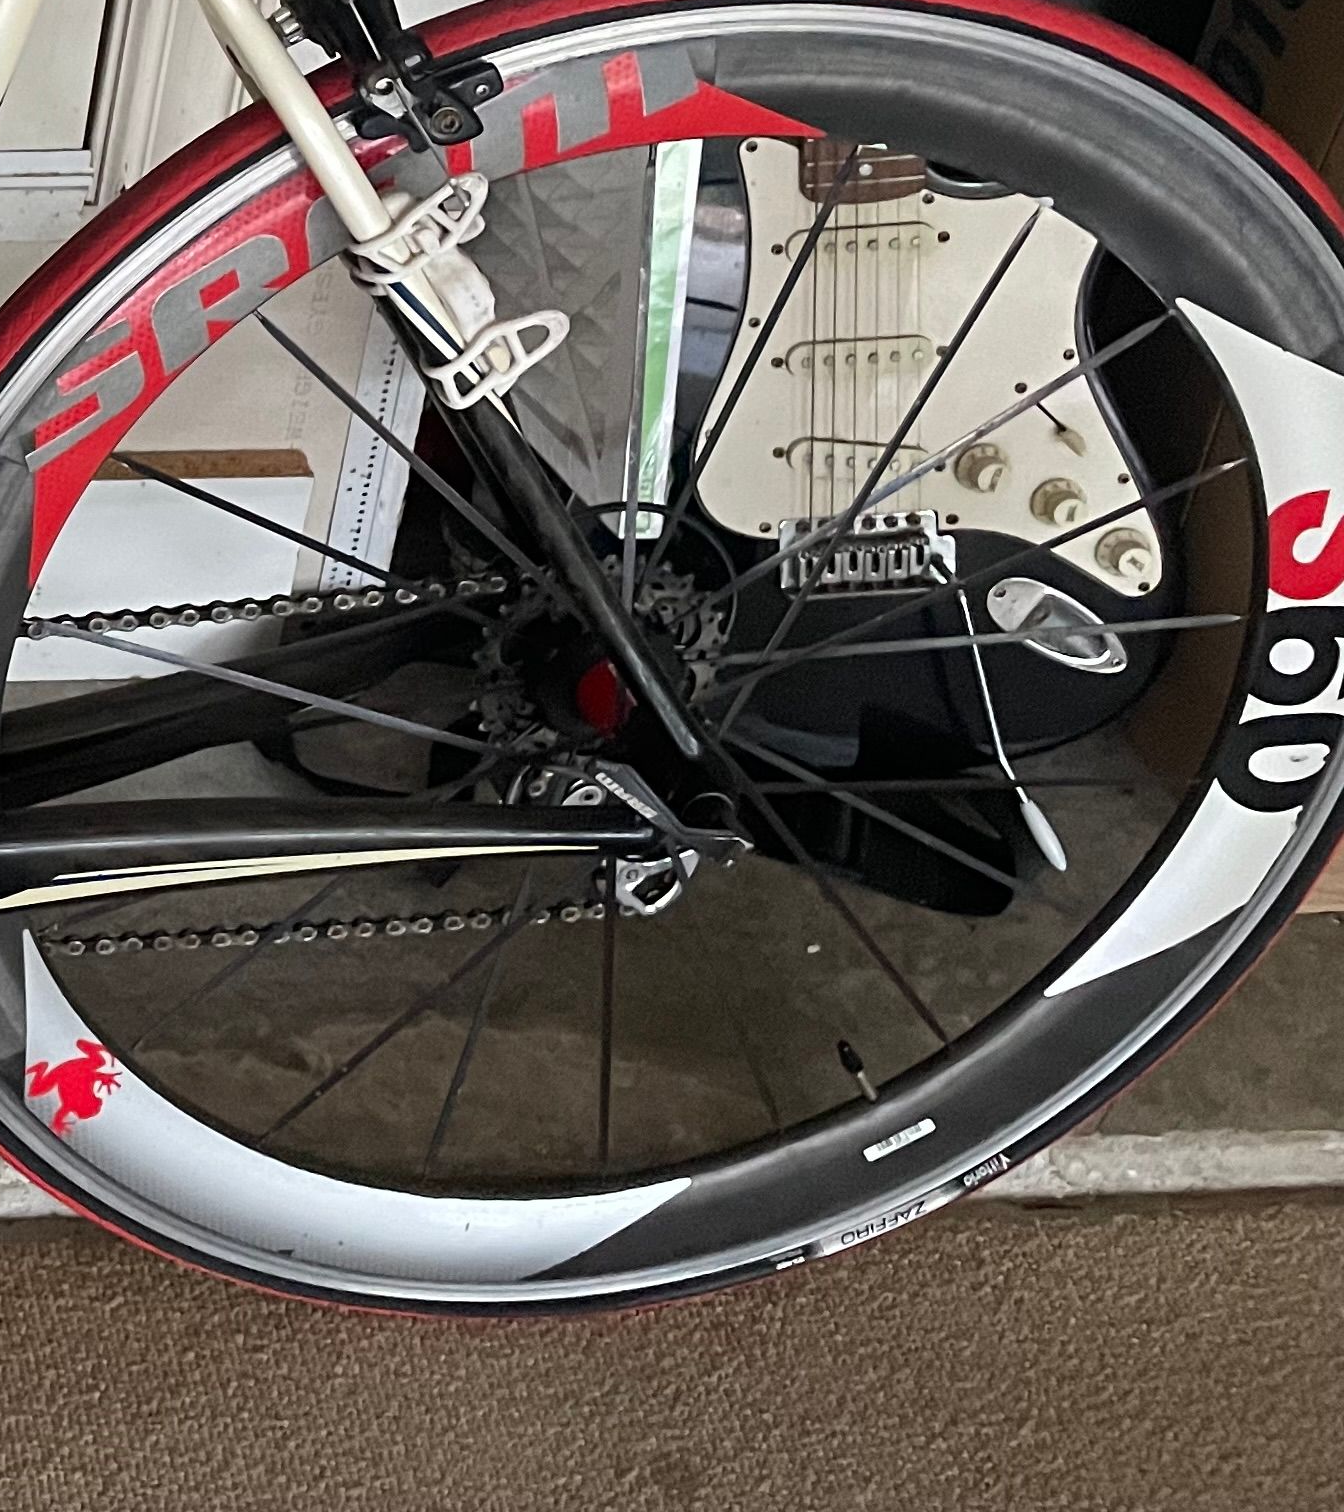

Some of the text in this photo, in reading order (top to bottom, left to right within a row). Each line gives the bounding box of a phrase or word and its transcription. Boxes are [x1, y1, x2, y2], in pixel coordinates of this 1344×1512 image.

[595, 772, 658, 819] SRAM
[841, 1152, 1011, 1245] Vittoria ZAFFIRO
